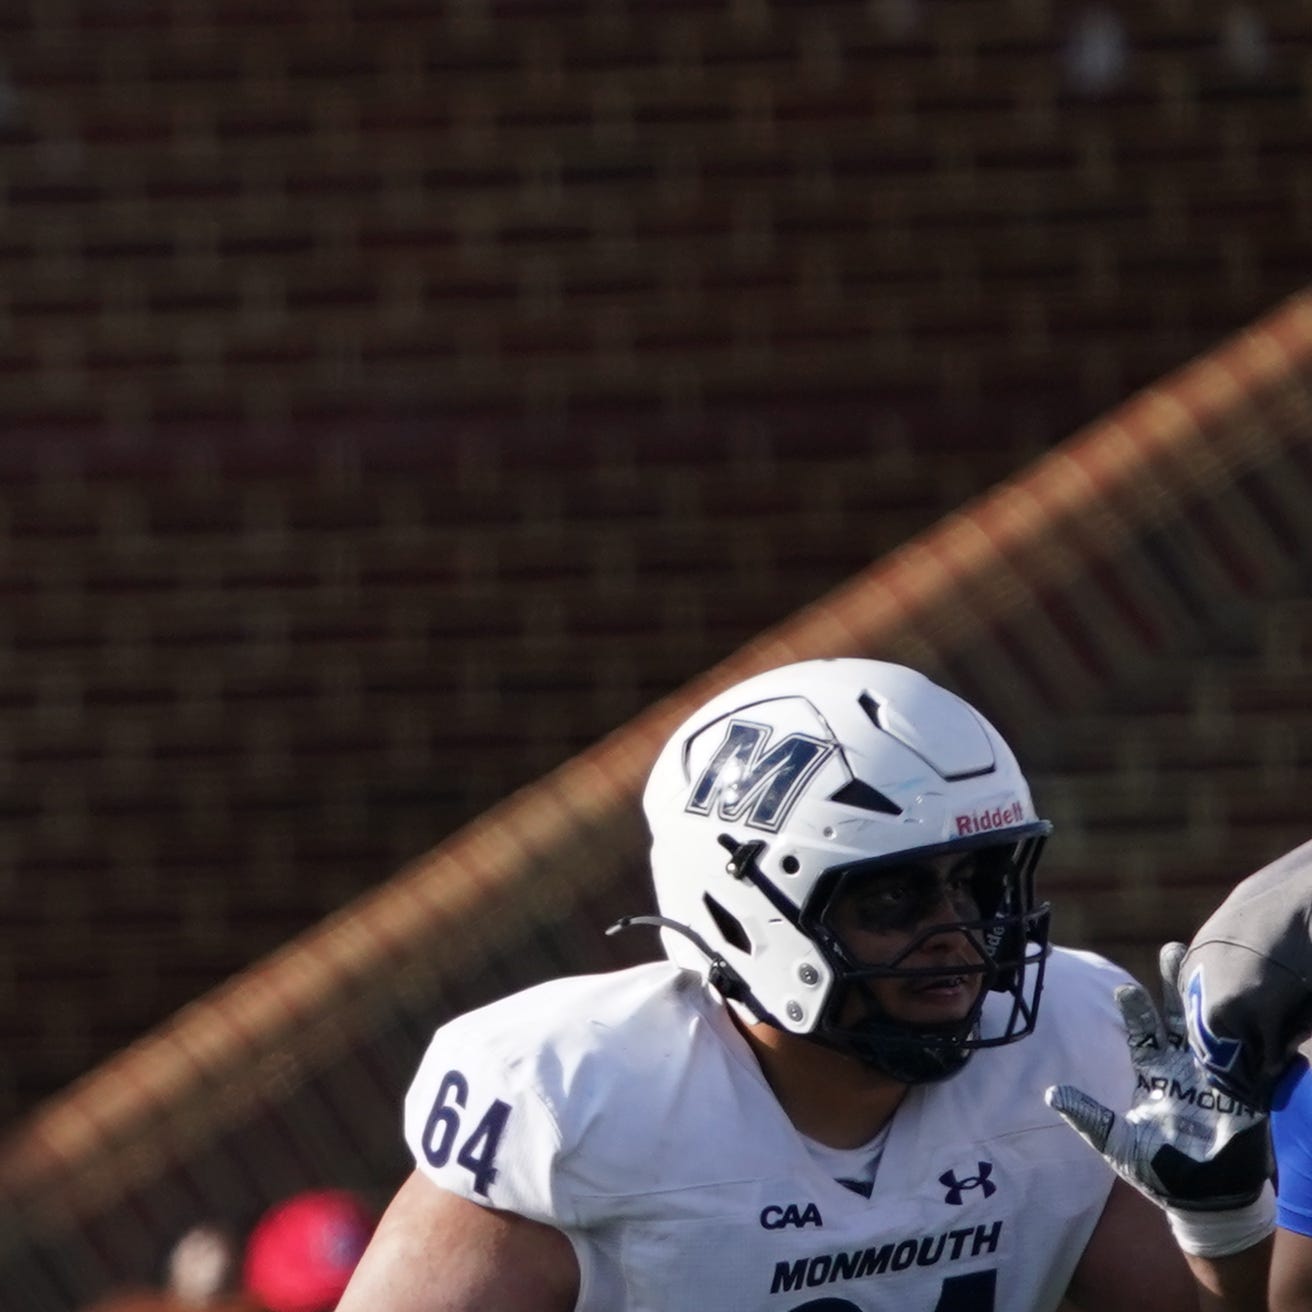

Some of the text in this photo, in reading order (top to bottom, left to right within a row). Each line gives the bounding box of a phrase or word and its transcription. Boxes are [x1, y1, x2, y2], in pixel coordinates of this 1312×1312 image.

[685, 719, 841, 834] M
[956, 801, 1024, 836] Riddell
[422, 1069, 512, 1198] 64
[760, 1202, 823, 1230] CAA
[770, 1221, 1003, 1294] MONMOUTH
